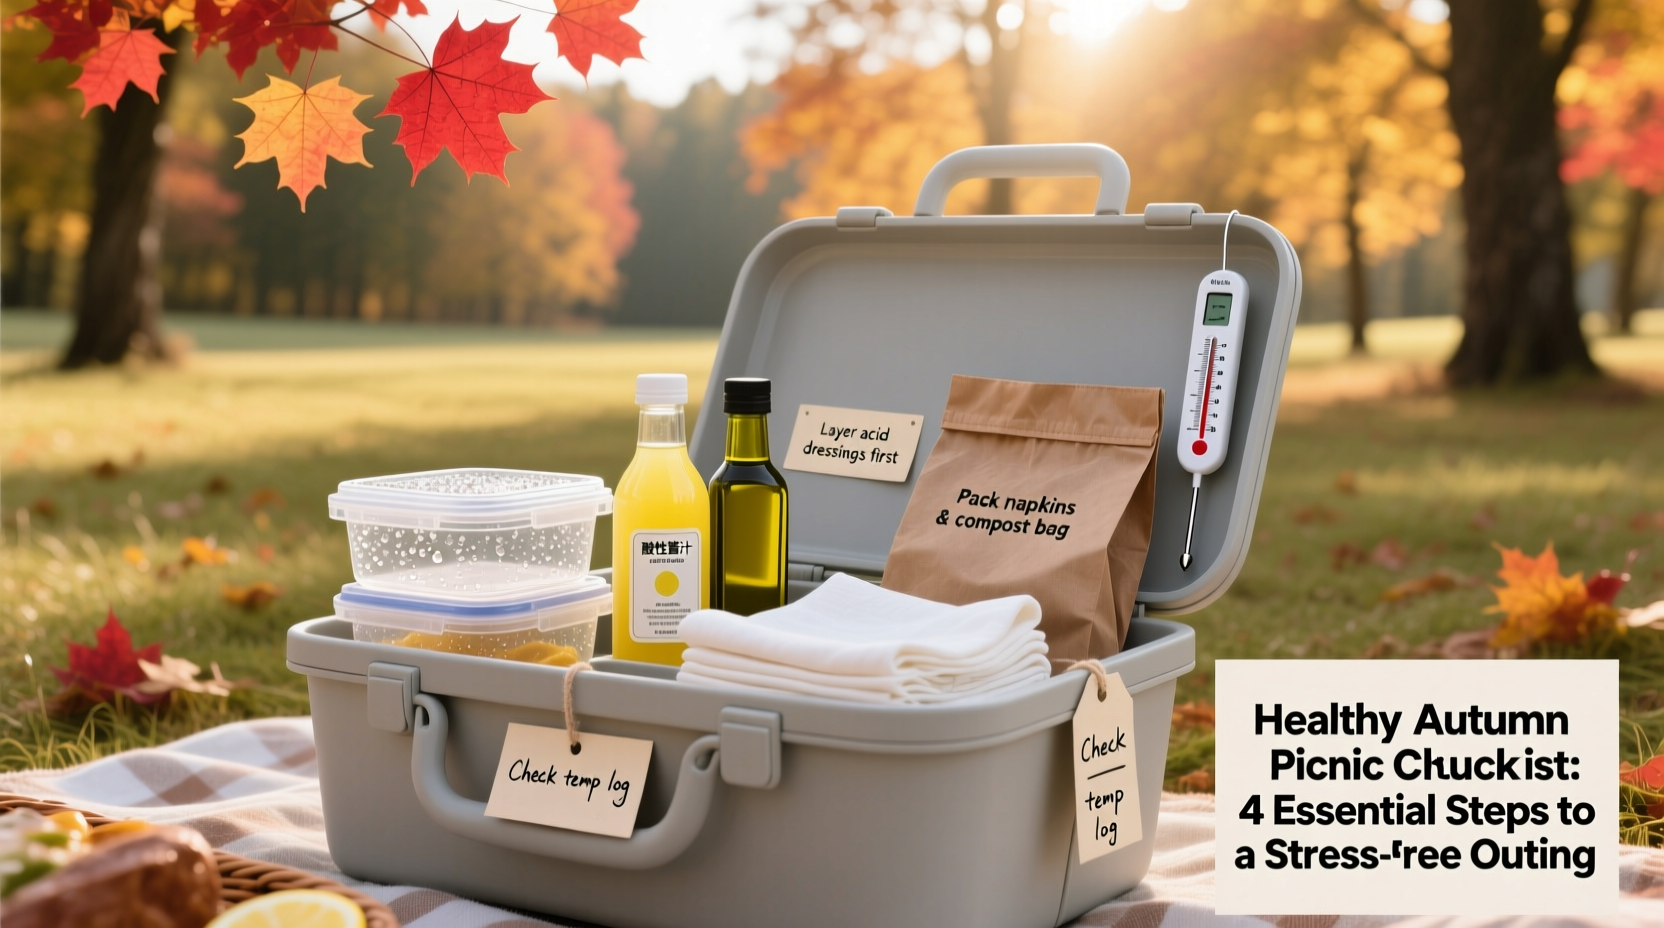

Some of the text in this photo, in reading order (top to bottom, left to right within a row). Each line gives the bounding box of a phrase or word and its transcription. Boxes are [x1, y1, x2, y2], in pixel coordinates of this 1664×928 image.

[819, 422, 891, 442] Layer acid
[802, 440, 900, 465] dressings first
[956, 488, 1077, 517] Pack napkins
[935, 508, 1071, 541] & compost bag
[1080, 726, 1127, 763] Check
[508, 757, 630, 808] Check temp log
[1084, 789, 1125, 816] temp
[1095, 815, 1119, 847] log
